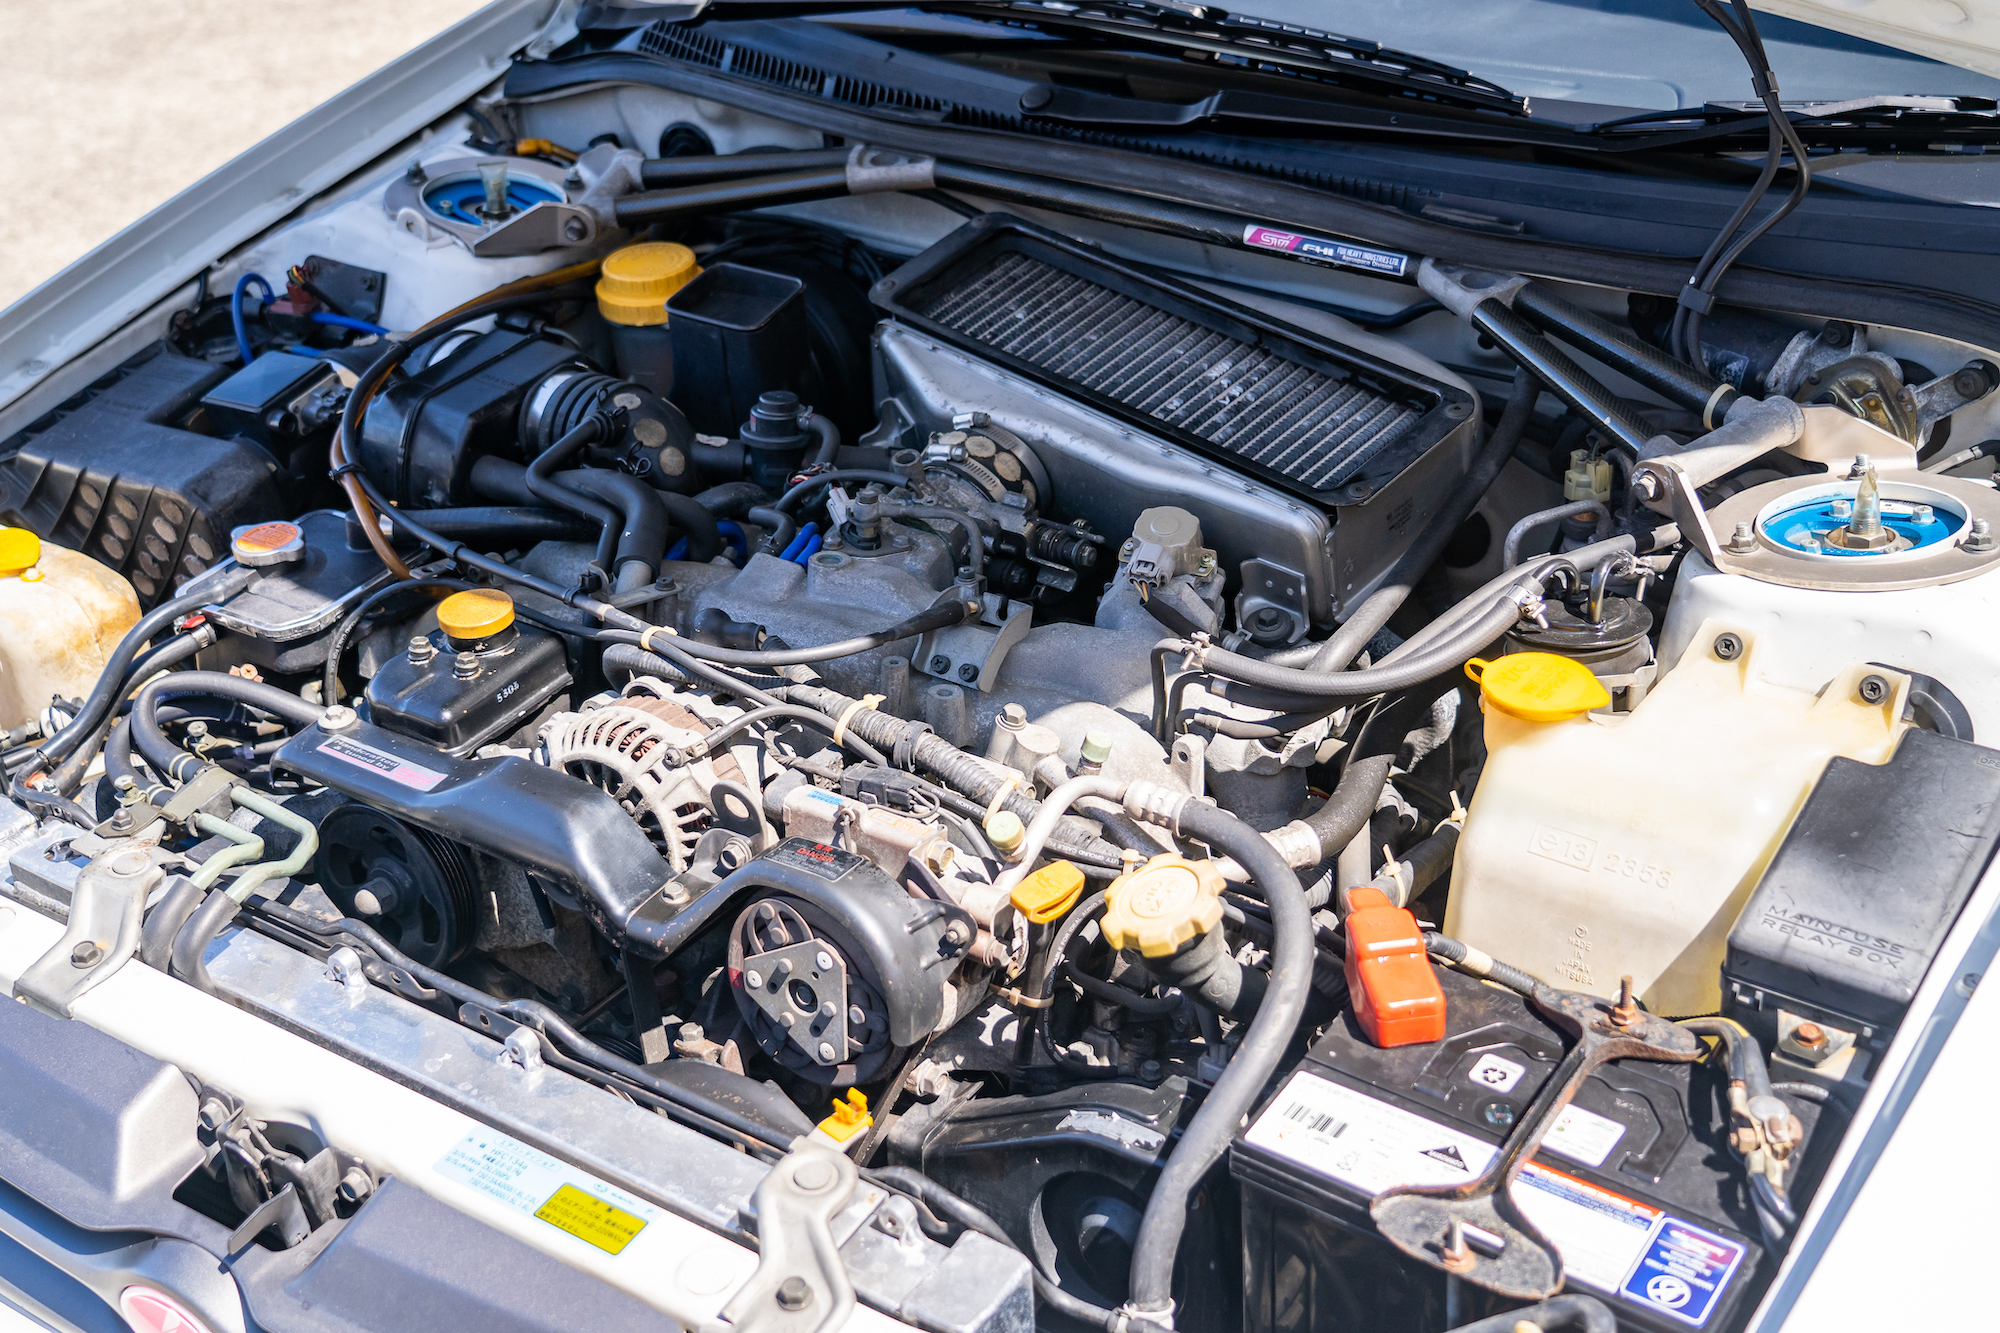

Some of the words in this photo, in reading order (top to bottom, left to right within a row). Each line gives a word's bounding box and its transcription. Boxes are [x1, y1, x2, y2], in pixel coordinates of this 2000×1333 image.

[1342, 255, 1371, 266] Aerospace
[1372, 261, 1394, 271] Division
[1347, 248, 1362, 258] HEAVY
[1362, 251, 1390, 264] INDUSTRIES
[333, 740, 401, 767] Handcrafted
[345, 749, 373, 764] tuned
[376, 762, 390, 771] by
[796, 847, 835, 863] DANGER
[1056, 844, 1077, 854] CABLE
[1078, 849, 1105, 861] GROUND
[1603, 853, 1674, 889] 2353
[1052, 945, 1063, 966] CABLE
[1060, 932, 1070, 946] FOR
[1068, 917, 1082, 932] IDEAL
[1081, 902, 1098, 917] AUDIO
[1567, 937, 1592, 952] MADE
[1760, 918, 1842, 949] RELAY
[1848, 946, 1901, 969] BOX
[1574, 949, 1583, 959] IN
[1562, 958, 1591, 973] JAPAN
[1427, 1150, 1464, 1169] CORROSIVE
